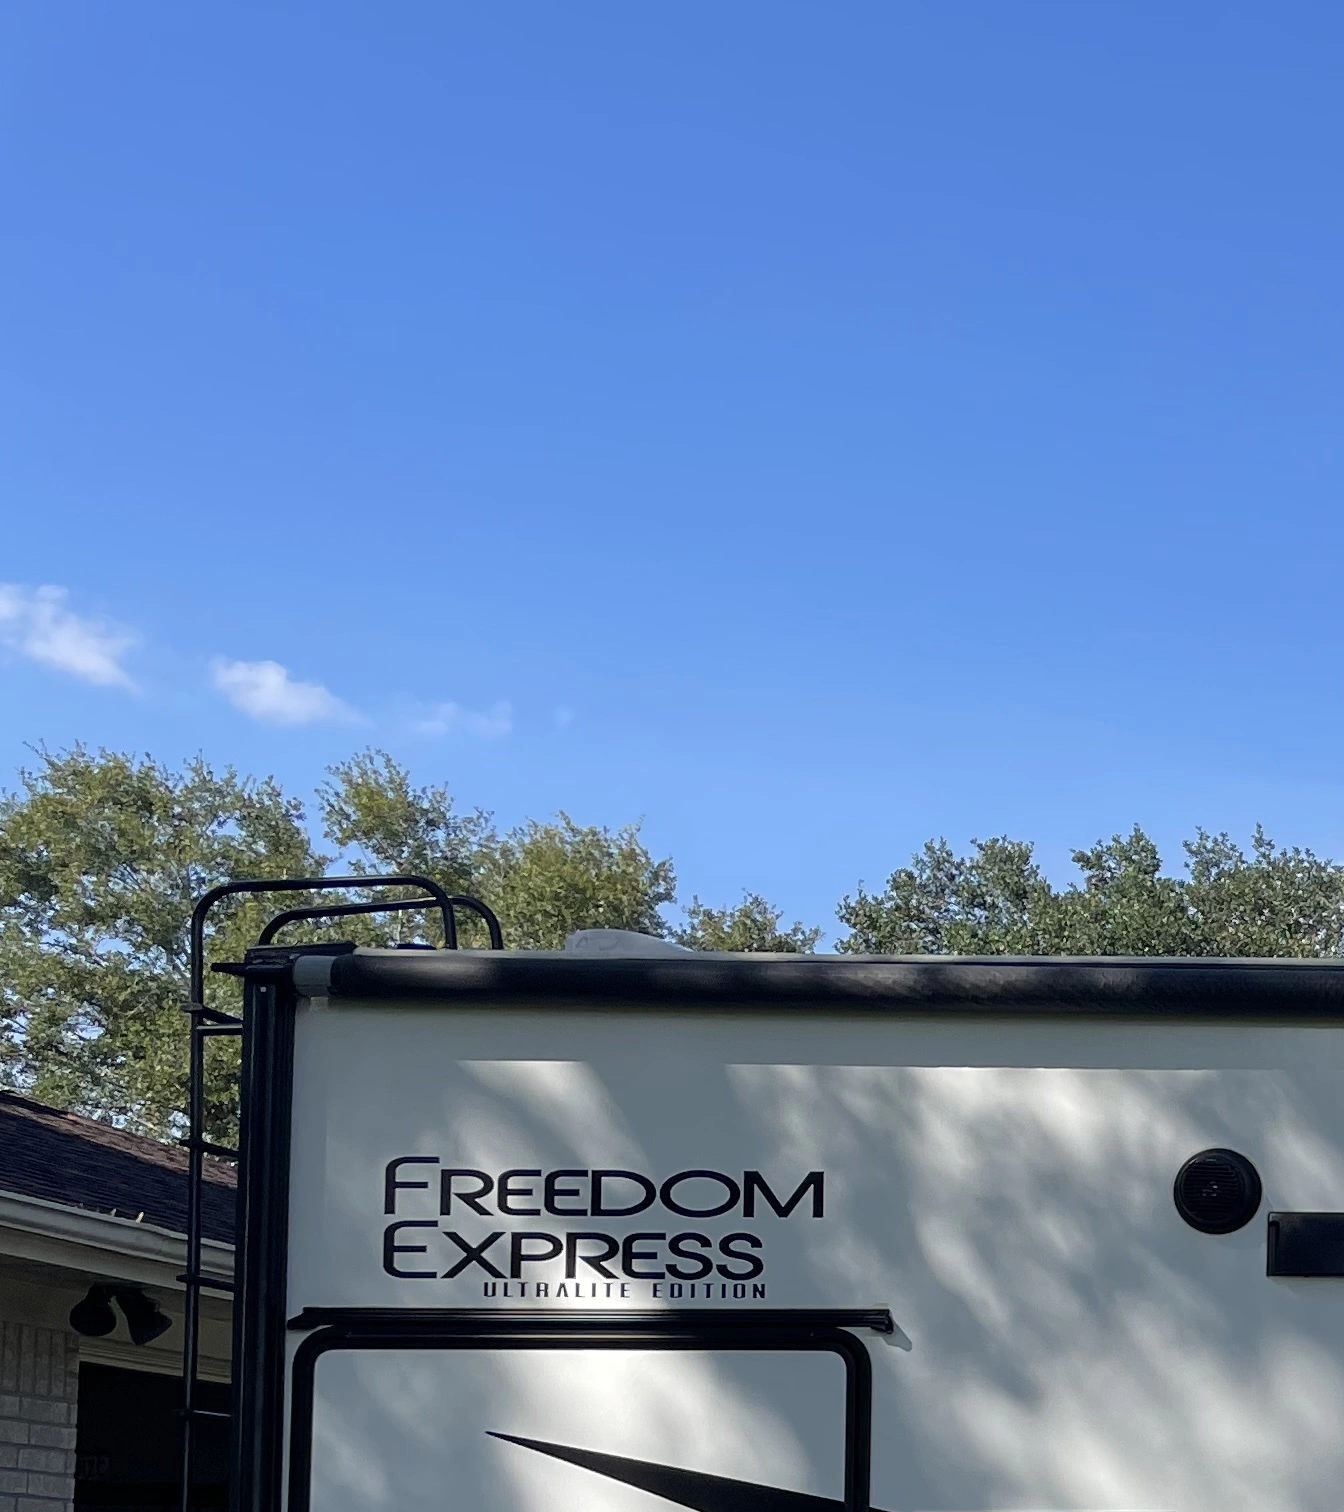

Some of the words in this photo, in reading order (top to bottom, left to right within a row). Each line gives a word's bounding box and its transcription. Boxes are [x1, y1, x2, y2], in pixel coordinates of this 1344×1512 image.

[383, 1156, 825, 1219] FREEDOM
[382, 1220, 764, 1281] EXPRESS
[483, 1282, 630, 1298] ULTRALITE
[652, 1282, 766, 1299] EDITION
